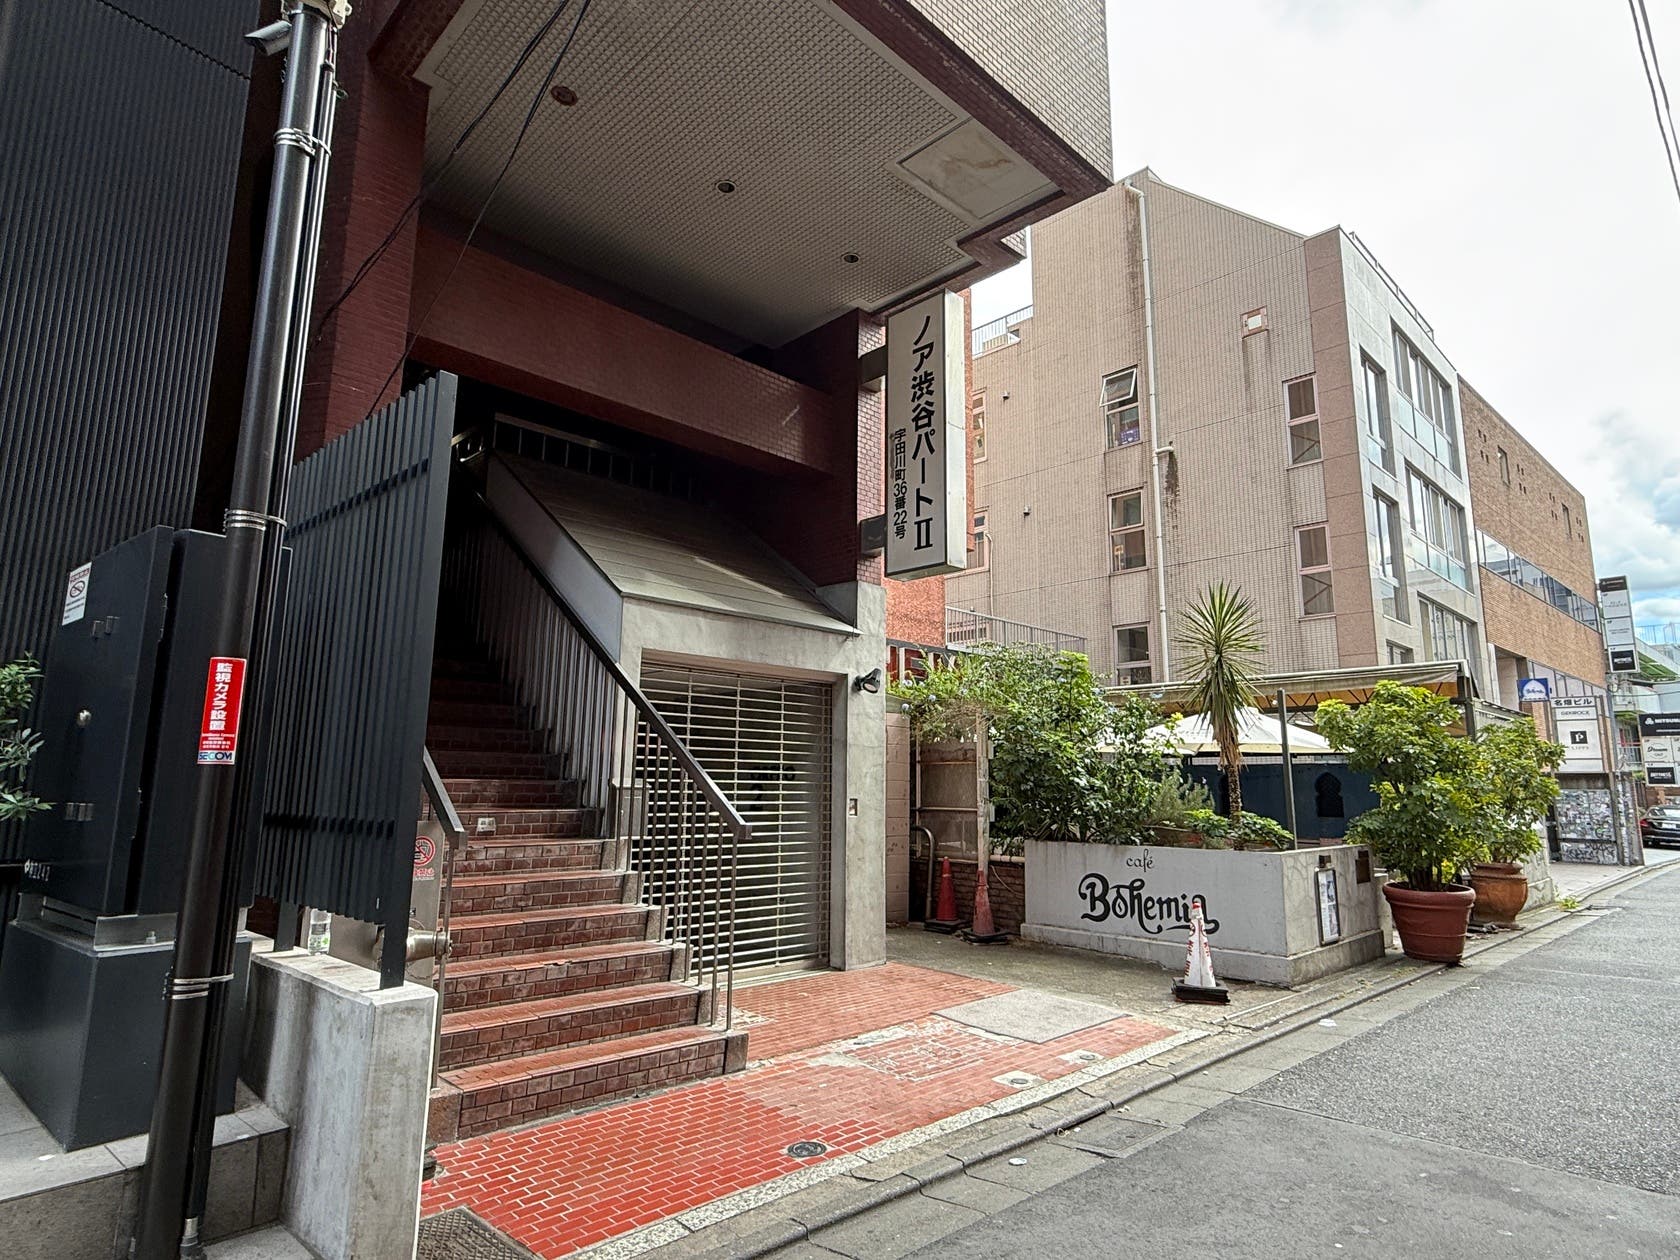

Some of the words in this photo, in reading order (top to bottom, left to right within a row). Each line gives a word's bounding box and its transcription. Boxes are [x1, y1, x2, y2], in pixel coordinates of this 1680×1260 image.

[893, 428, 908, 540] 宇田川町36番22号
[209, 662, 233, 731] 監視カメラ設置
[199, 751, 233, 761] SECOM
[1126, 849, 1154, 872] café
